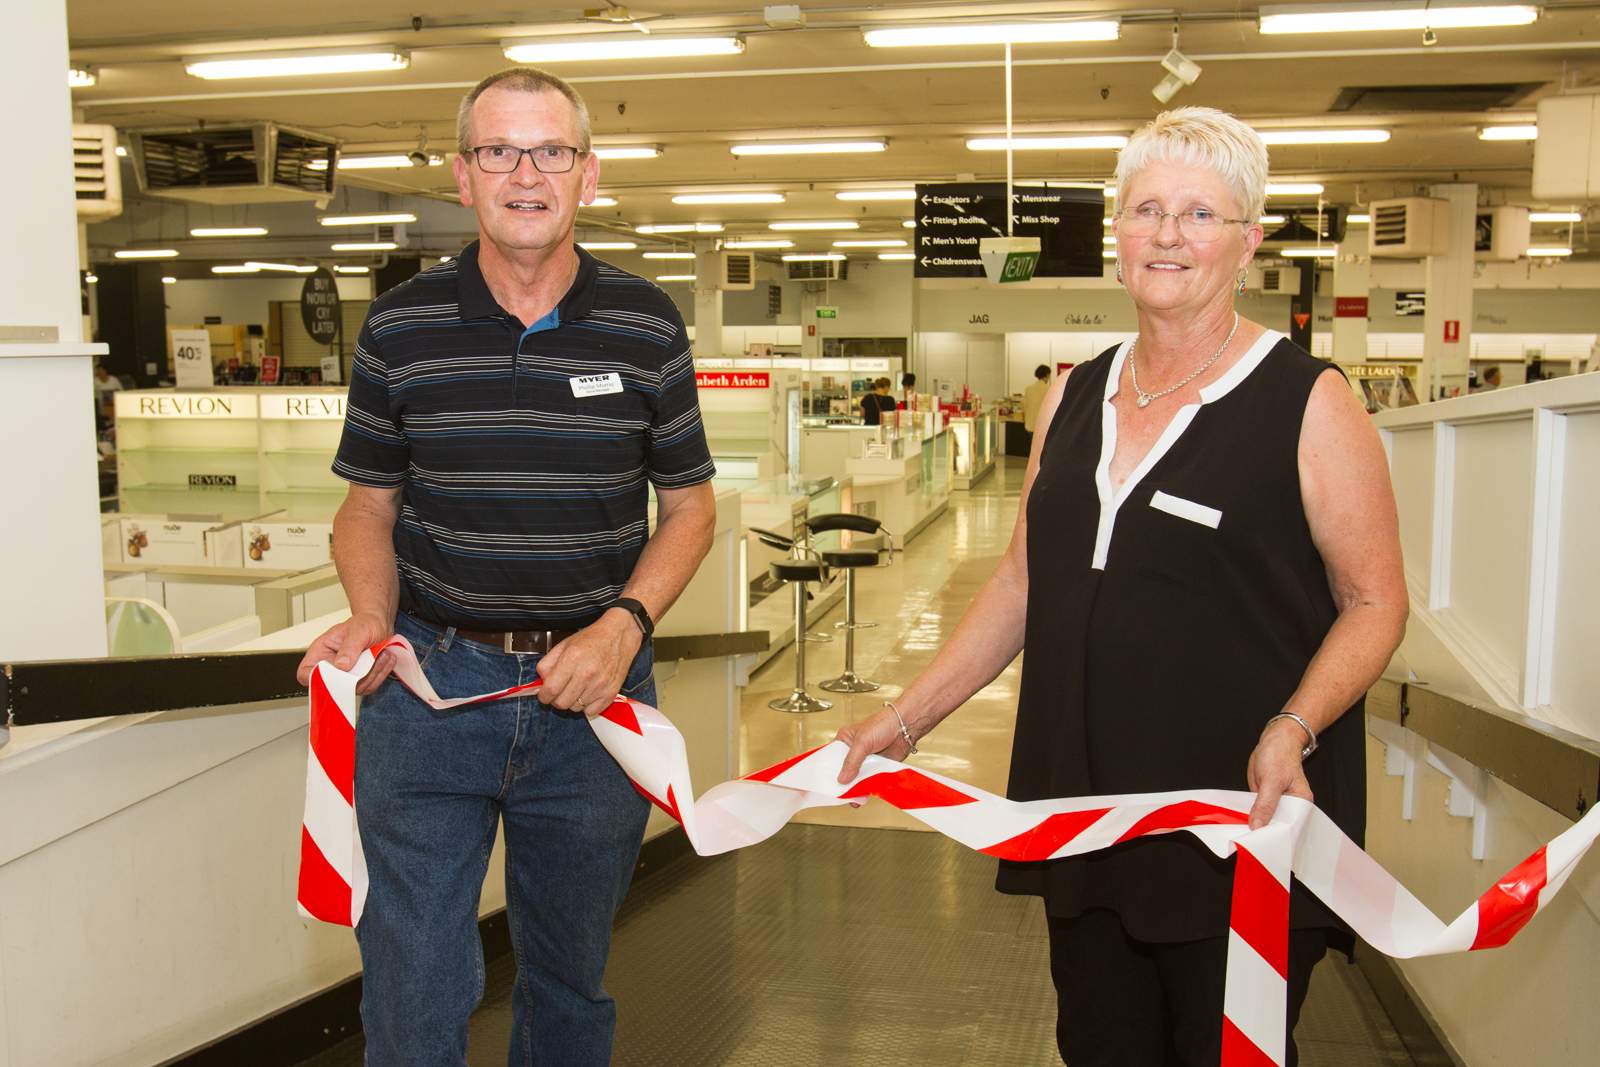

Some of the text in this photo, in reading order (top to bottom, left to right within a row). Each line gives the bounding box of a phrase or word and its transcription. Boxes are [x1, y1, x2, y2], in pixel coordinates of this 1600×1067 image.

[933, 216, 958, 226] Fitting
[1022, 215, 1059, 225] Miss Shop
[933, 236, 978, 245] Men's Youth
[1008, 256, 1032, 278] EXIT
[968, 314, 989, 324] JAG
[177, 346, 194, 360] 40
[579, 375, 609, 383] MYER
[696, 374, 766, 387] abeth Arden
[140, 397, 232, 415] REVLON
[287, 398, 346, 415] REVL
[190, 475, 233, 486] REVLON
